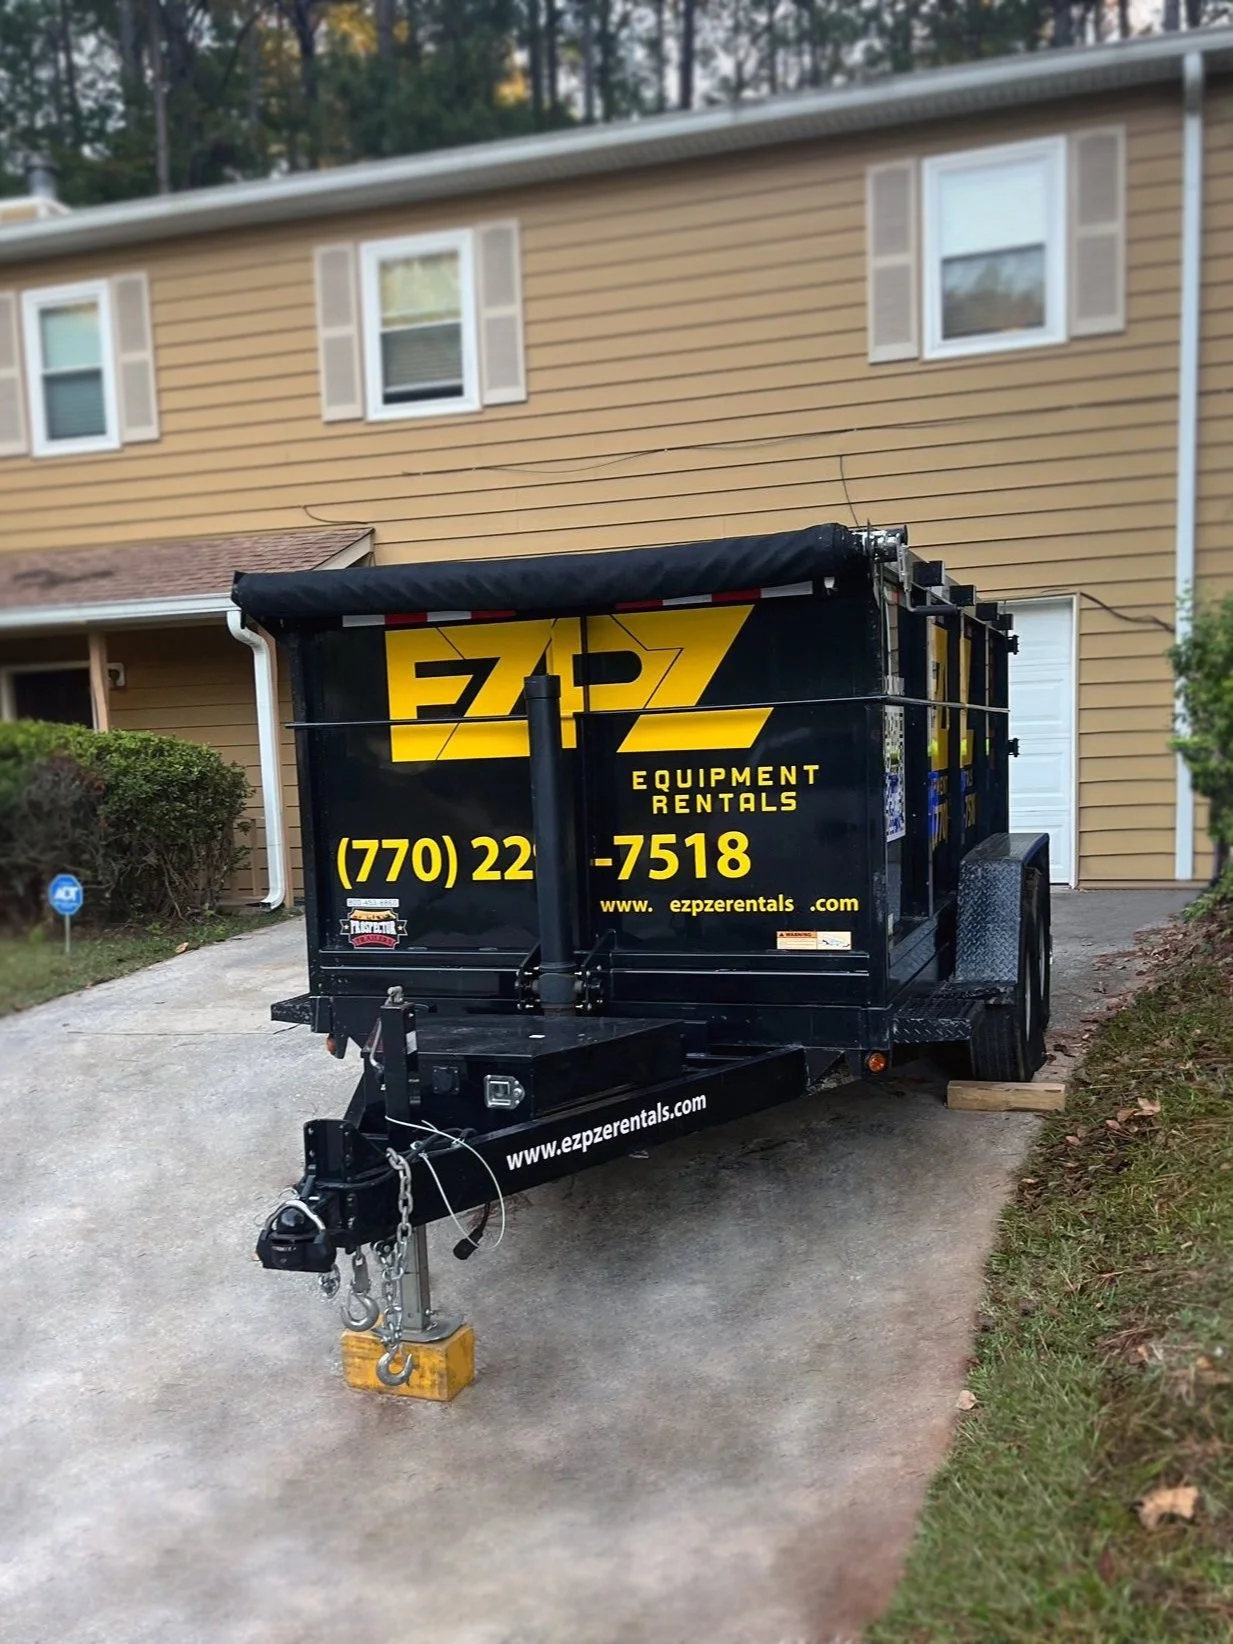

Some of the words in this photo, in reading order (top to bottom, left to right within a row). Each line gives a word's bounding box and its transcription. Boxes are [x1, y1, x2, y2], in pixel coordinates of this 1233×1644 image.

[632, 764, 819, 790] EQUIPMENT
[652, 792, 798, 814] RENTALS
[337, 835, 458, 890] (770)
[53, 886, 79, 901] ADT
[600, 900, 654, 913] www.
[670, 895, 794, 916] ezpzerentals
[809, 898, 859, 913] .com
[350, 919, 397, 935] PROSPECTOR
[506, 1094, 708, 1171] www.ezpzerentals.com
